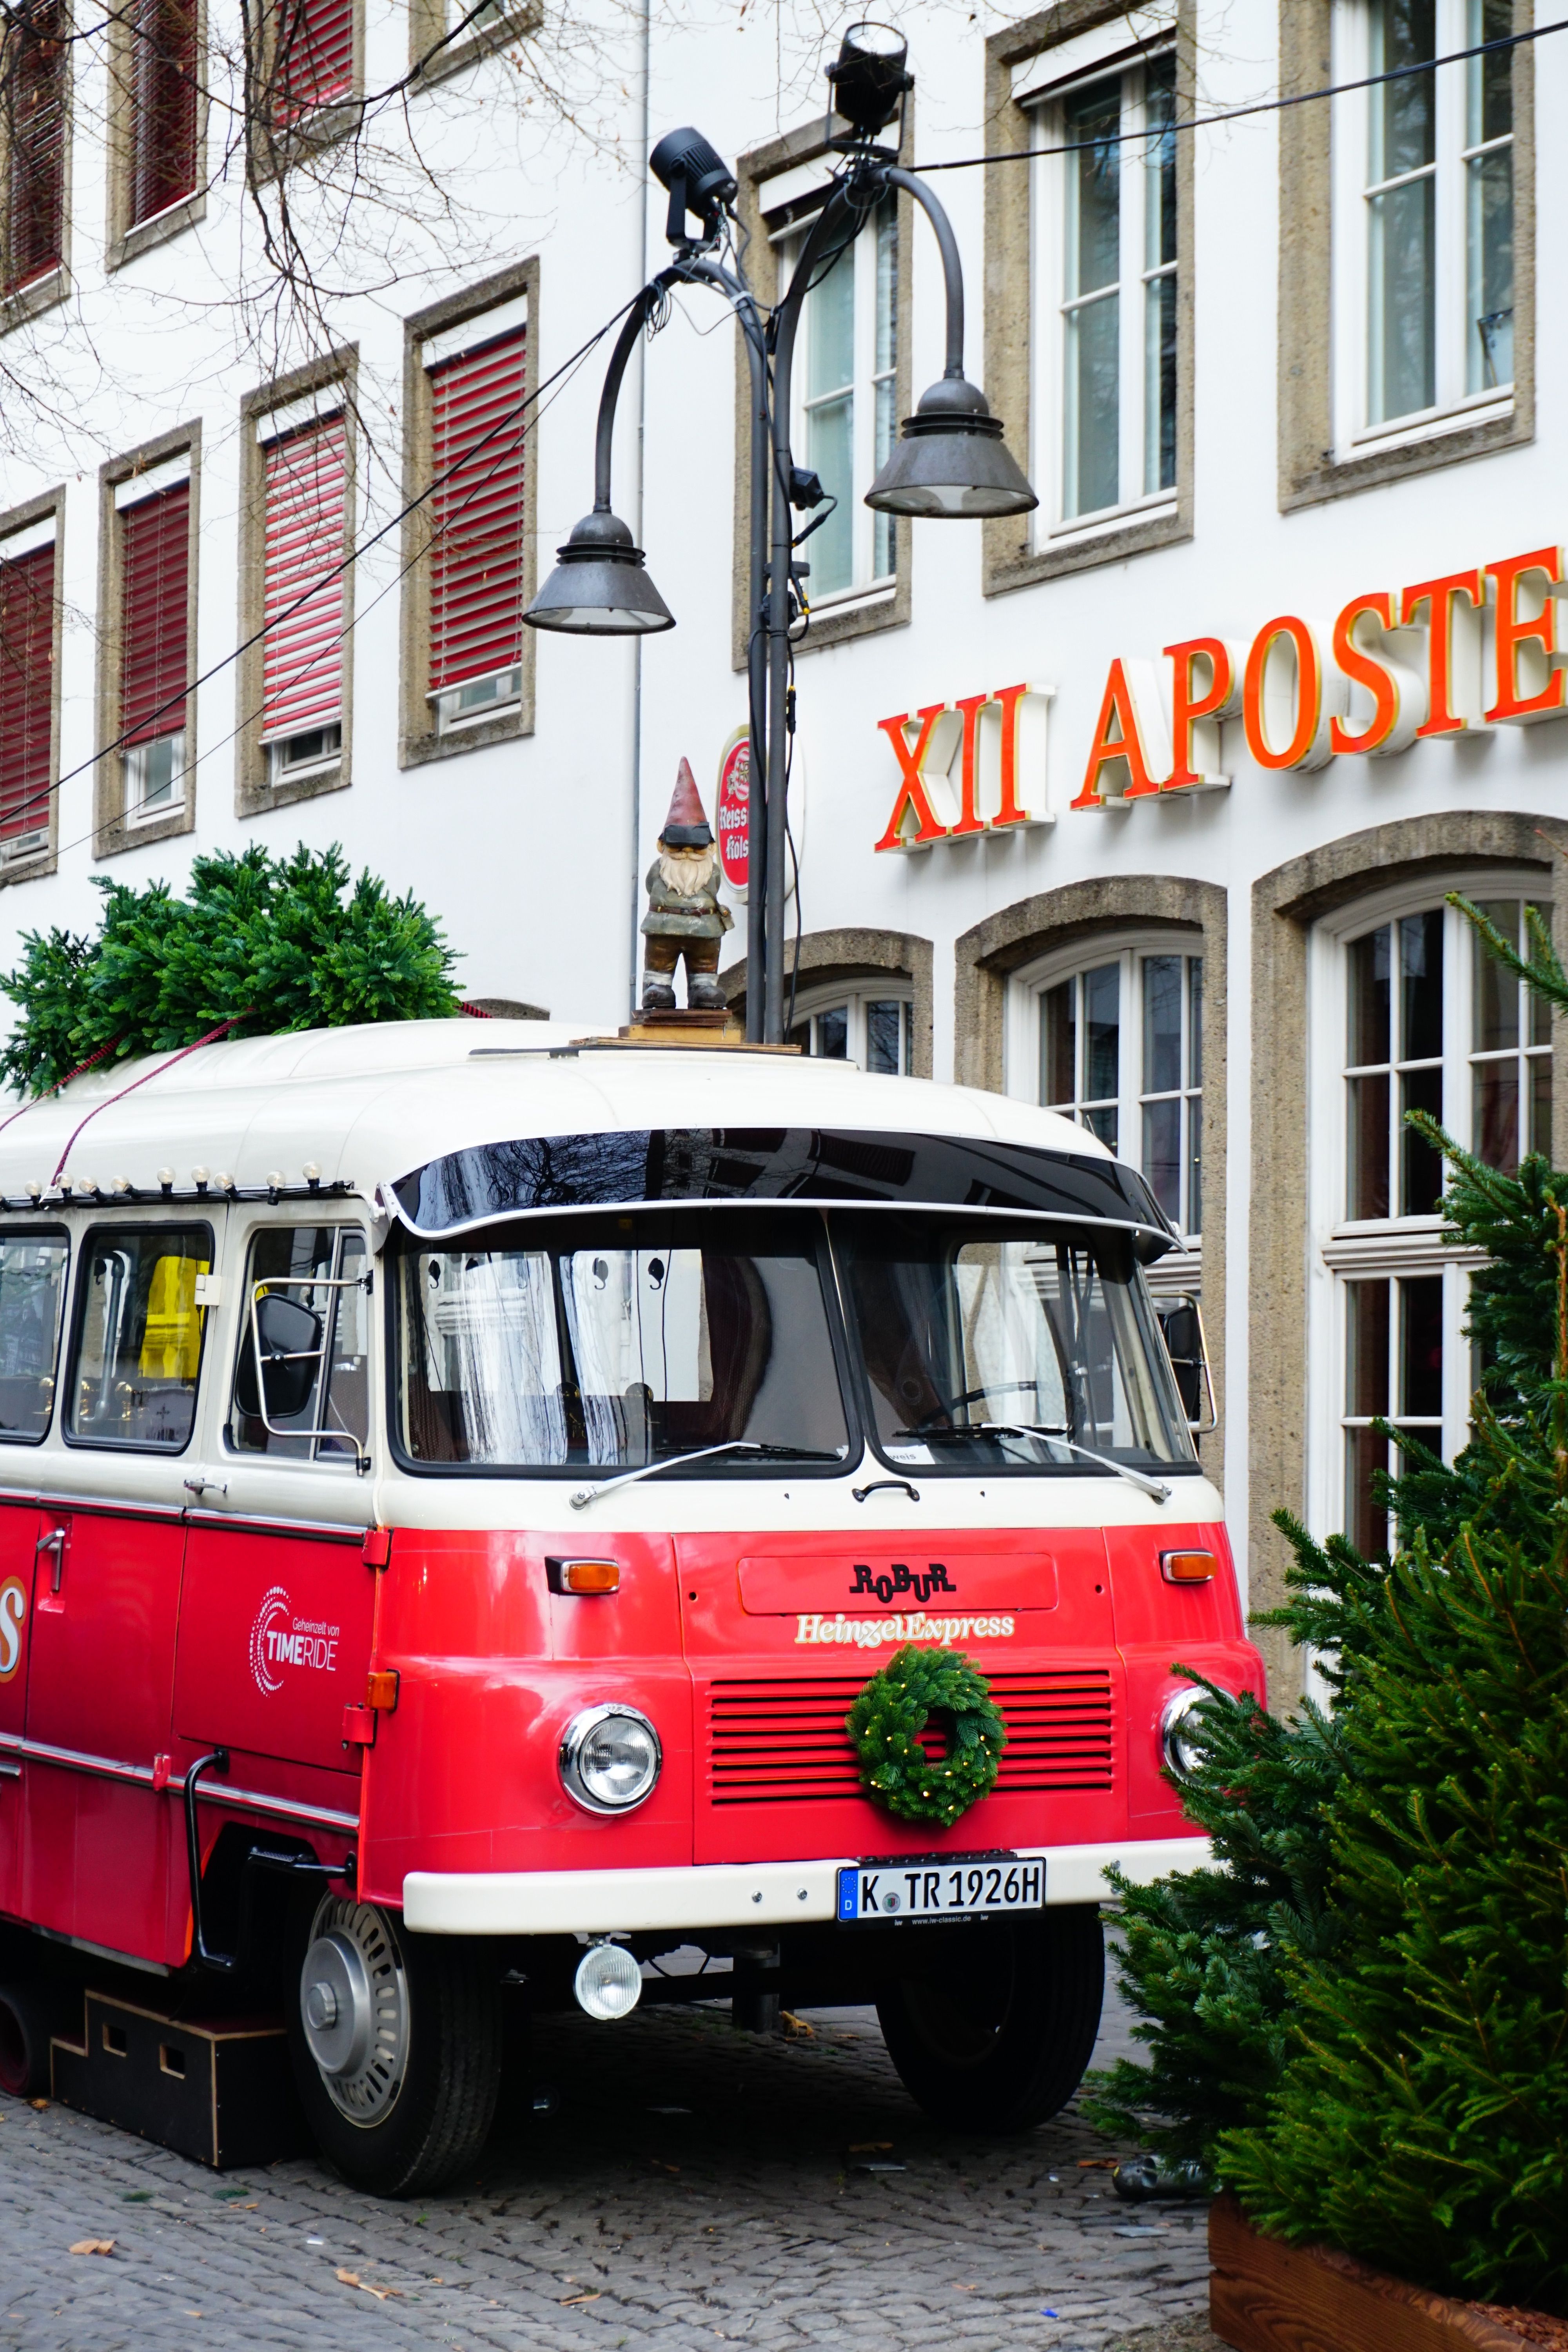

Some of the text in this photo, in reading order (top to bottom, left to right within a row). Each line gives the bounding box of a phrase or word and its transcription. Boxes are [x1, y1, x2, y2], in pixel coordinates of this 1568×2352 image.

[875, 545, 1563, 853] XII APOSTE
[720, 804, 748, 830] Reiss
[726, 835, 748, 860] Köls
[292, 1617, 339, 1637] Geheinzelt von
[267, 1630, 338, 1671] TIMERIDE
[862, 1875, 879, 1911] K
[904, 1872, 940, 1909] TR
[948, 1867, 1039, 1906] 1926H
[845, 1900, 852, 1911] D
[912, 1915, 971, 1925] www.iw-classic.de
